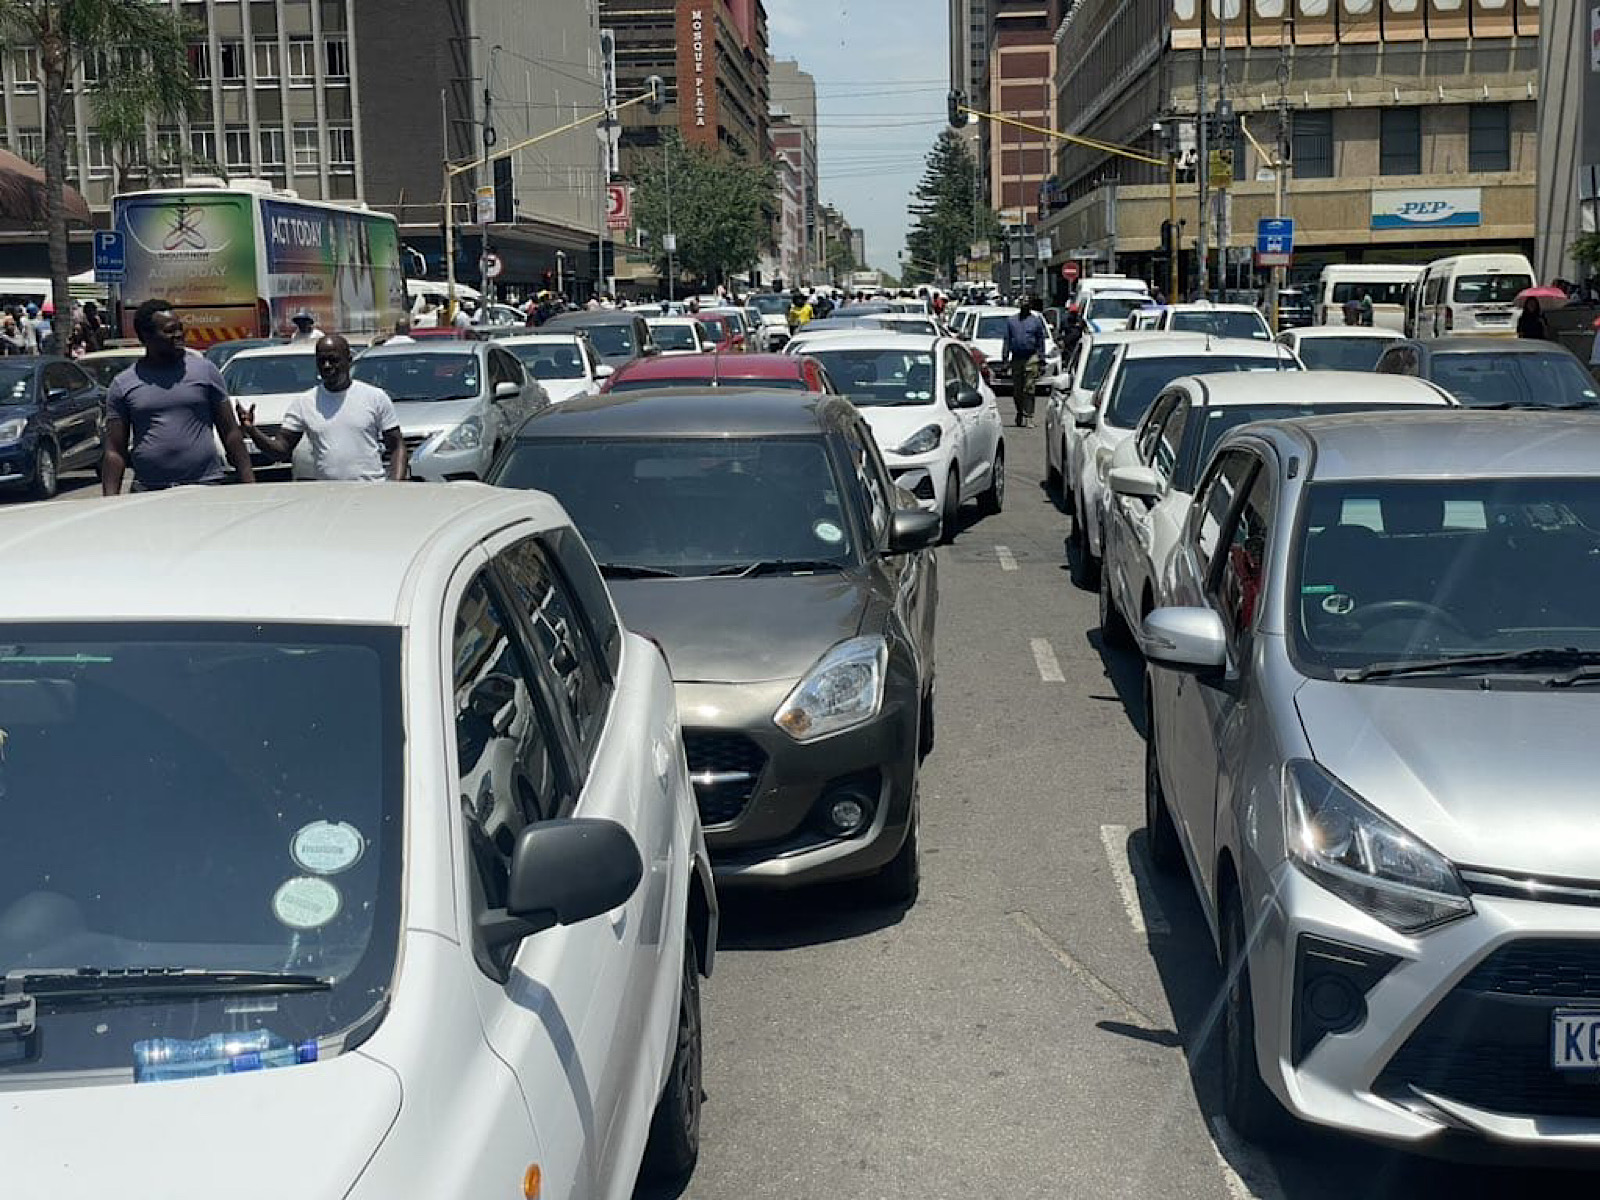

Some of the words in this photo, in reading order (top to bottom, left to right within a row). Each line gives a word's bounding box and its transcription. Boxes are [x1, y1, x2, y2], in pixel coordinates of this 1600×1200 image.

[692, 10, 703, 73] MOSQUE
[695, 77, 705, 126] PLAZA
[1399, 201, 1449, 215] PEP
[101, 234, 116, 251] P
[271, 215, 290, 245] ACT
[291, 218, 323, 247] TODAY
